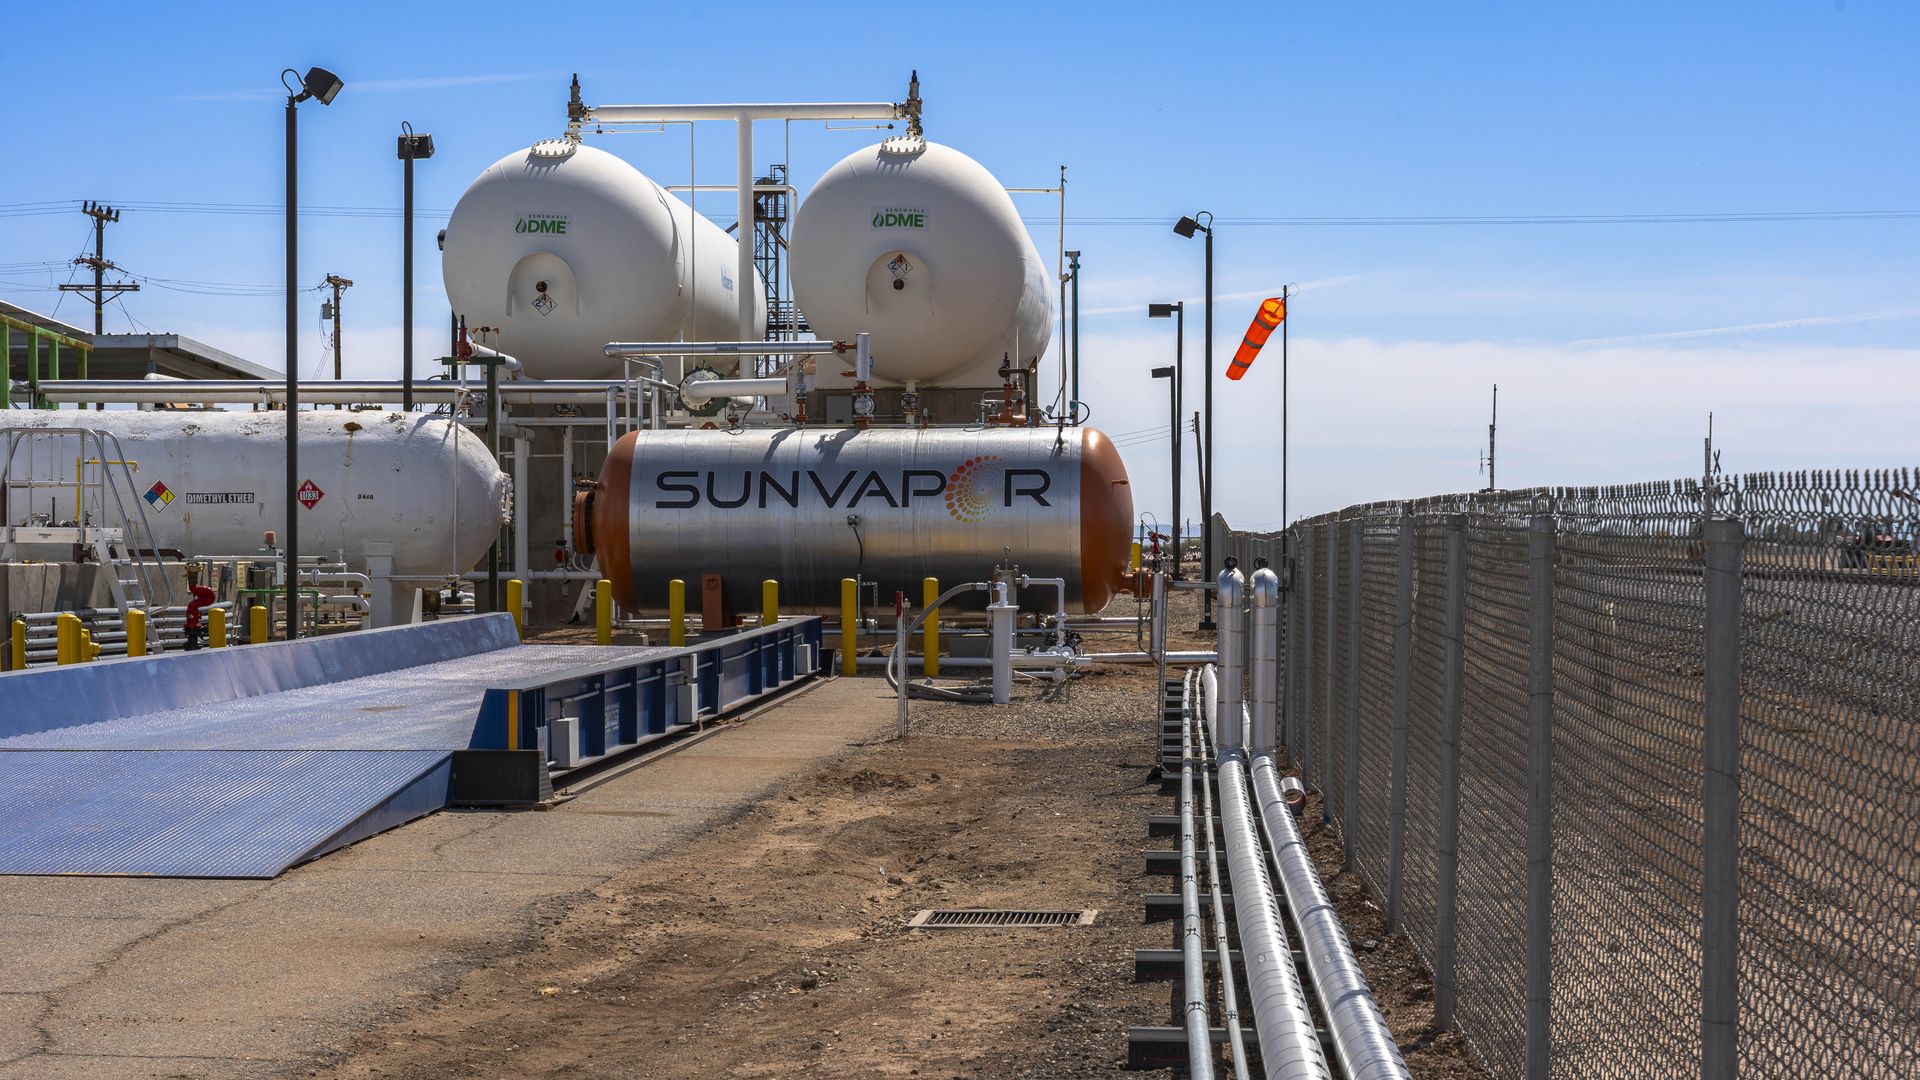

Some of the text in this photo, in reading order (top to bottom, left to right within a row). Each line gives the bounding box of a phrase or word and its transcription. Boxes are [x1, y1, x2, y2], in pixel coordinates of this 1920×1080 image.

[885, 214, 924, 228] DME
[527, 220, 567, 234] DME
[890, 261, 898, 270] 2
[541, 293, 547, 301] 4
[535, 299, 542, 307] 2
[187, 493, 254, 503] DIMETHYL ETHER
[301, 491, 318, 499] 1033
